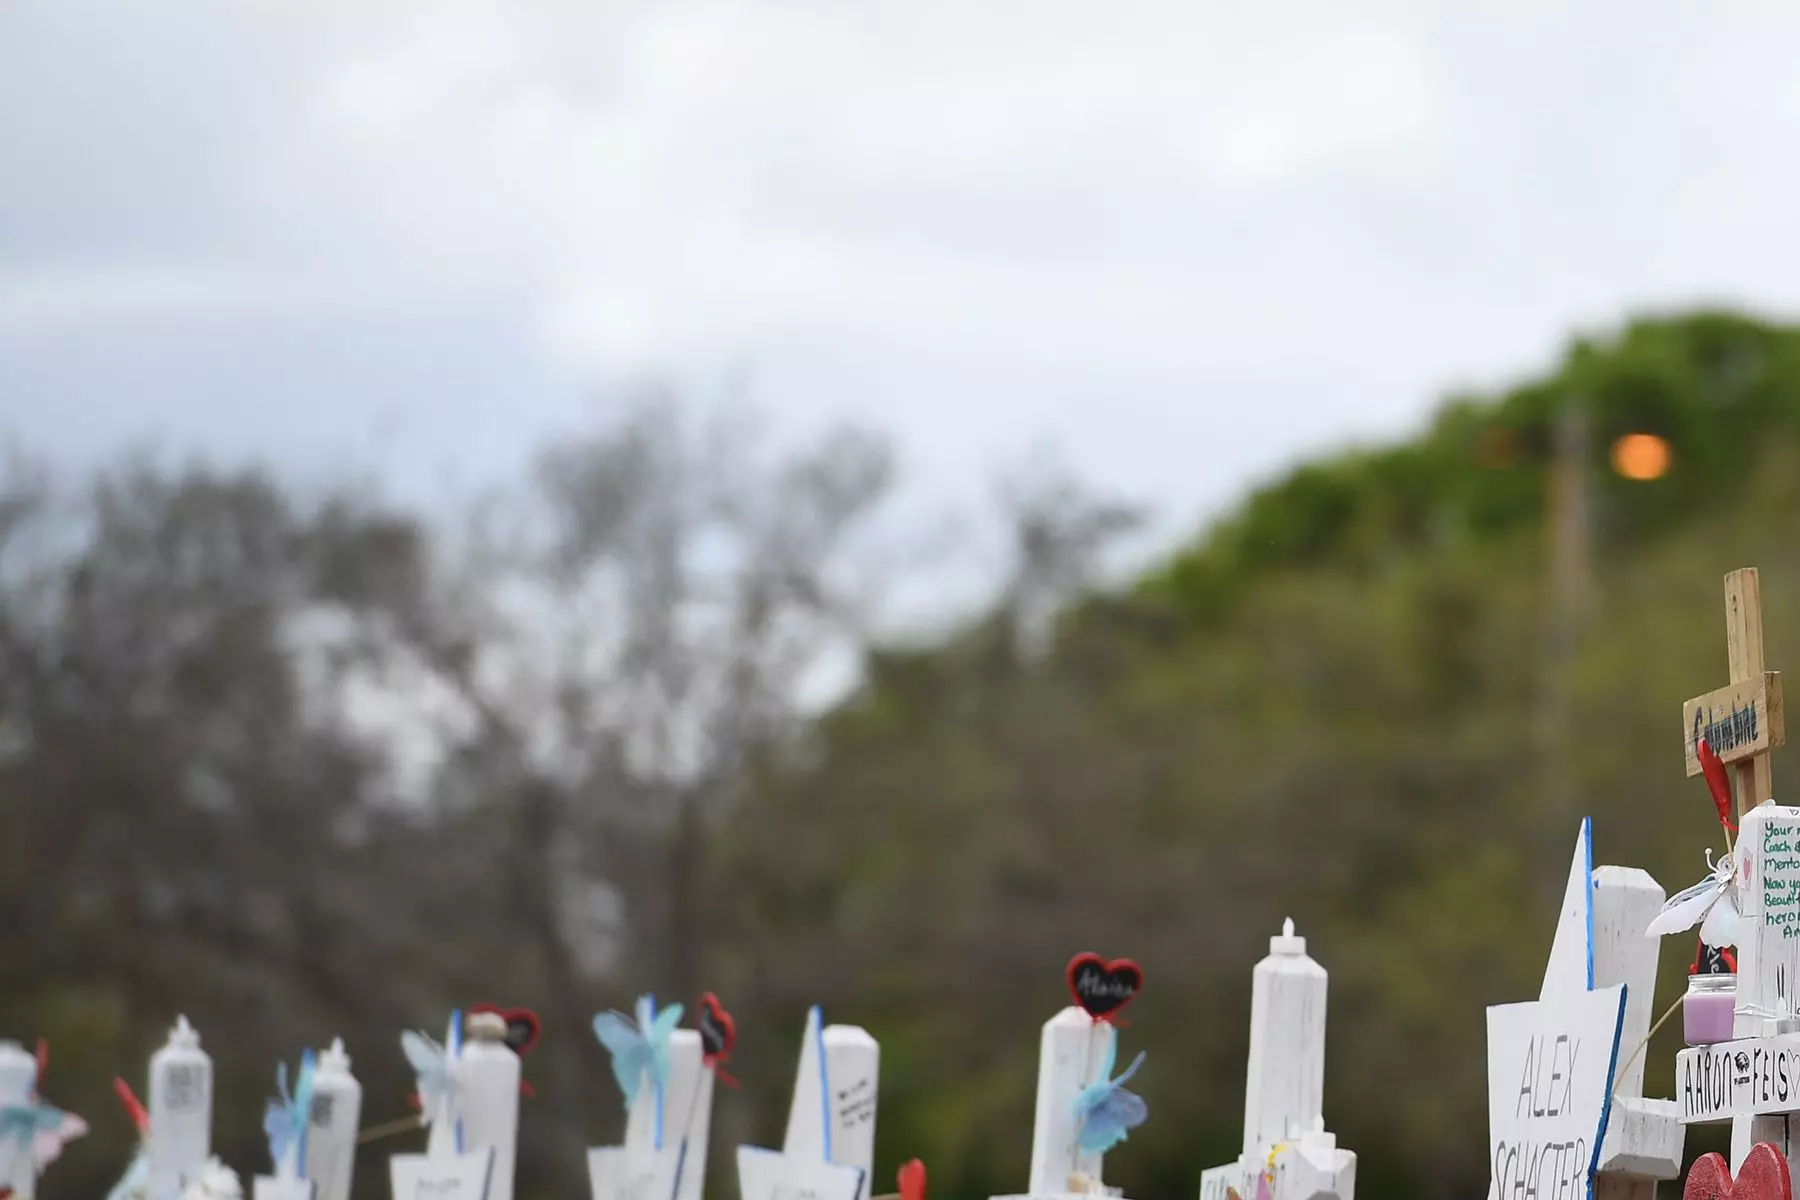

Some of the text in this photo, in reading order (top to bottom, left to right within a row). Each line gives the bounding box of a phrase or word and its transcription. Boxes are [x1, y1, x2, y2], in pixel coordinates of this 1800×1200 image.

[1694, 699, 1759, 762] Columbine
[1763, 838, 1792, 854] Coach
[1765, 821, 1793, 838] Your
[1763, 875, 1786, 890] Now
[1516, 1033, 1580, 1119] ALEX
[1684, 1050, 1733, 1118] AARON
[1752, 1047, 1789, 1106] FEIS
